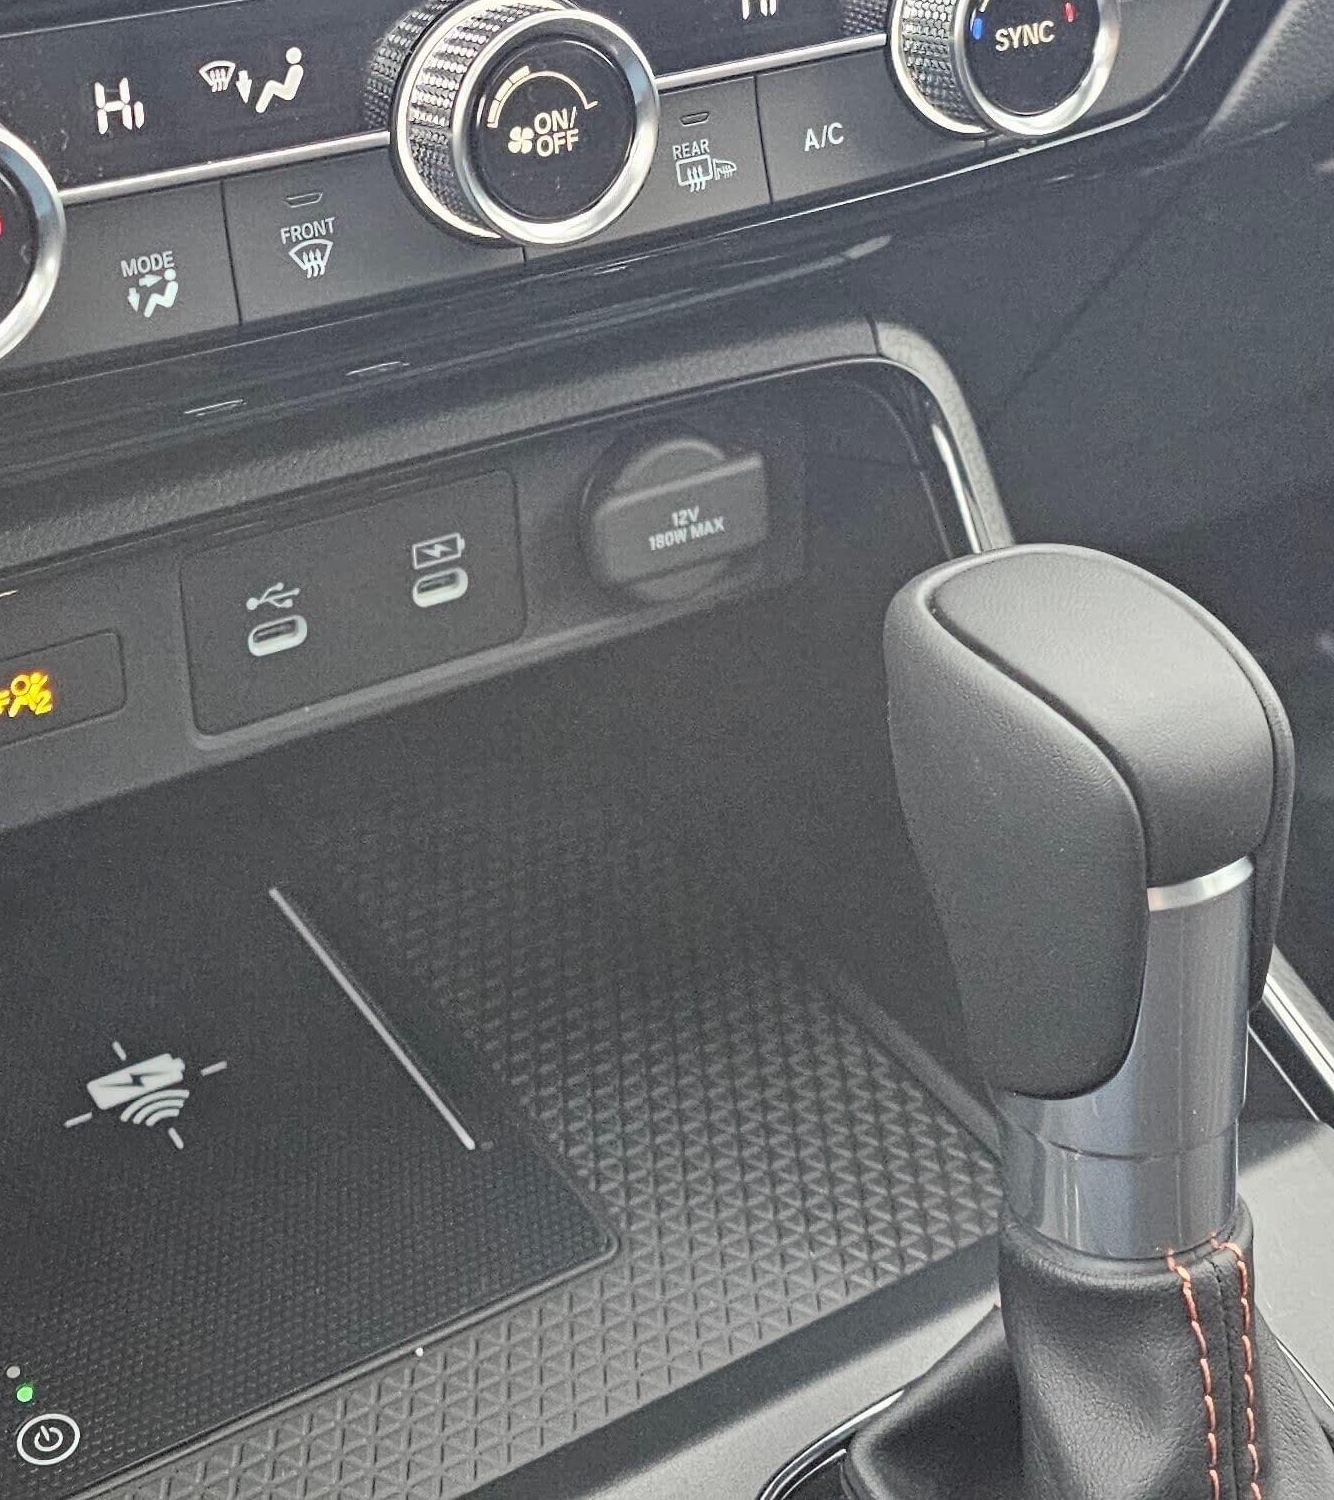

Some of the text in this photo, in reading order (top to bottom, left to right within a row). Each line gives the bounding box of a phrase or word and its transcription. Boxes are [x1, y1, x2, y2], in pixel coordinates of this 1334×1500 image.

[994, 20, 1056, 53] SYNC
[534, 106, 577, 133] ON/
[535, 127, 580, 159] OFF
[672, 139, 710, 160] REAR
[803, 122, 845, 152] A/C
[280, 217, 337, 245] FRONT
[120, 250, 175, 278] MODE
[671, 505, 699, 527] 12V
[690, 515, 726, 539] MAX
